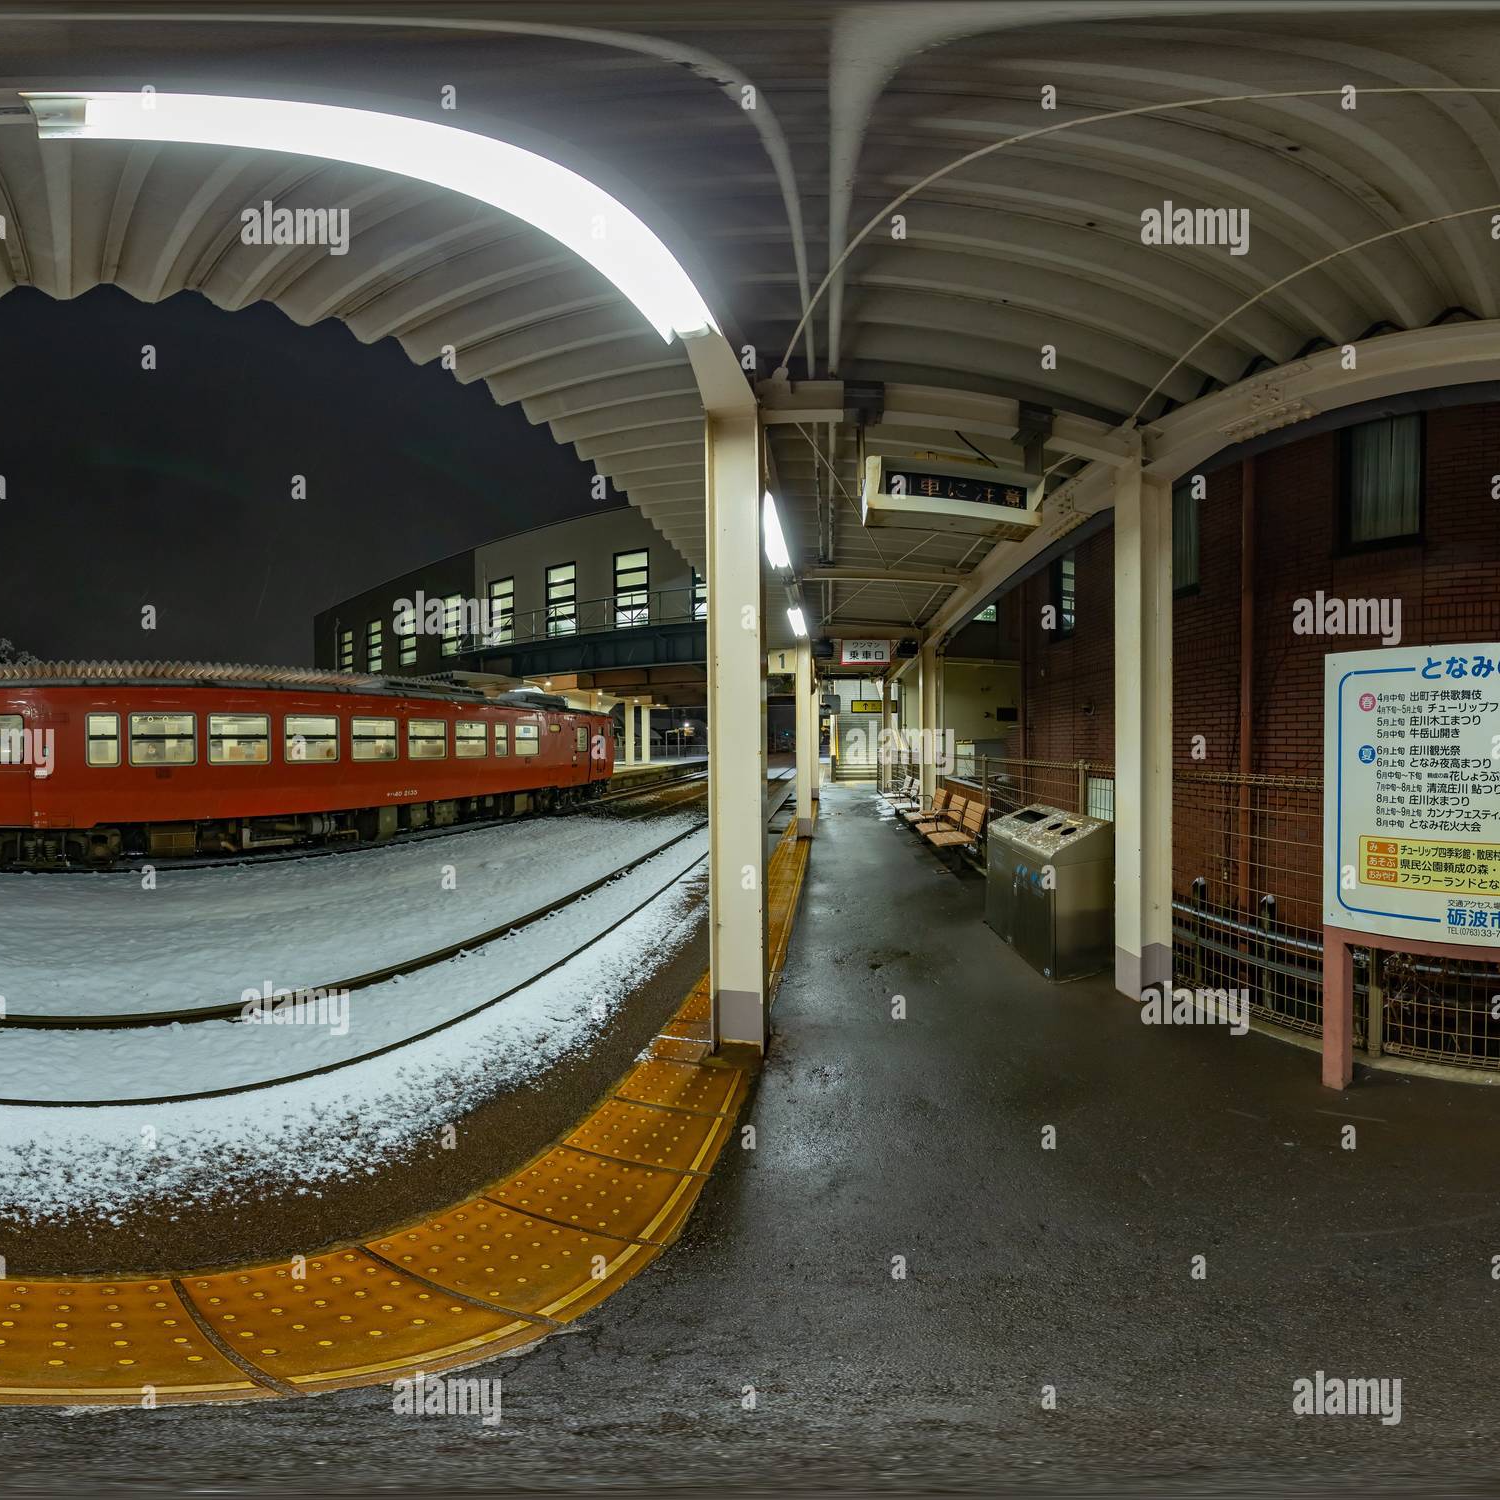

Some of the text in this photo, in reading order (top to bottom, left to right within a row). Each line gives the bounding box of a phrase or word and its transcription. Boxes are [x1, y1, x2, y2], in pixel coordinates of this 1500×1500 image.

[778, 653, 785, 669] 1
[1422, 655, 1500, 679] となみ
[1377, 690, 1482, 703] 4月中旬 出町子供歌舞伎
[1377, 715, 1481, 727] 5月上旬 庄川木工まつり
[1377, 728, 1460, 739] 5月中旬 牛岳山開き
[1377, 745, 1461, 756] 6月上旬 庄川観光祭
[1376, 757, 1492, 769] 6月上旬 となみ夜高まつり
[1376, 793, 1470, 807] 8月上旬 庄川水まつり
[1376, 817, 1481, 832] 8月中旬 となみ花火大会
